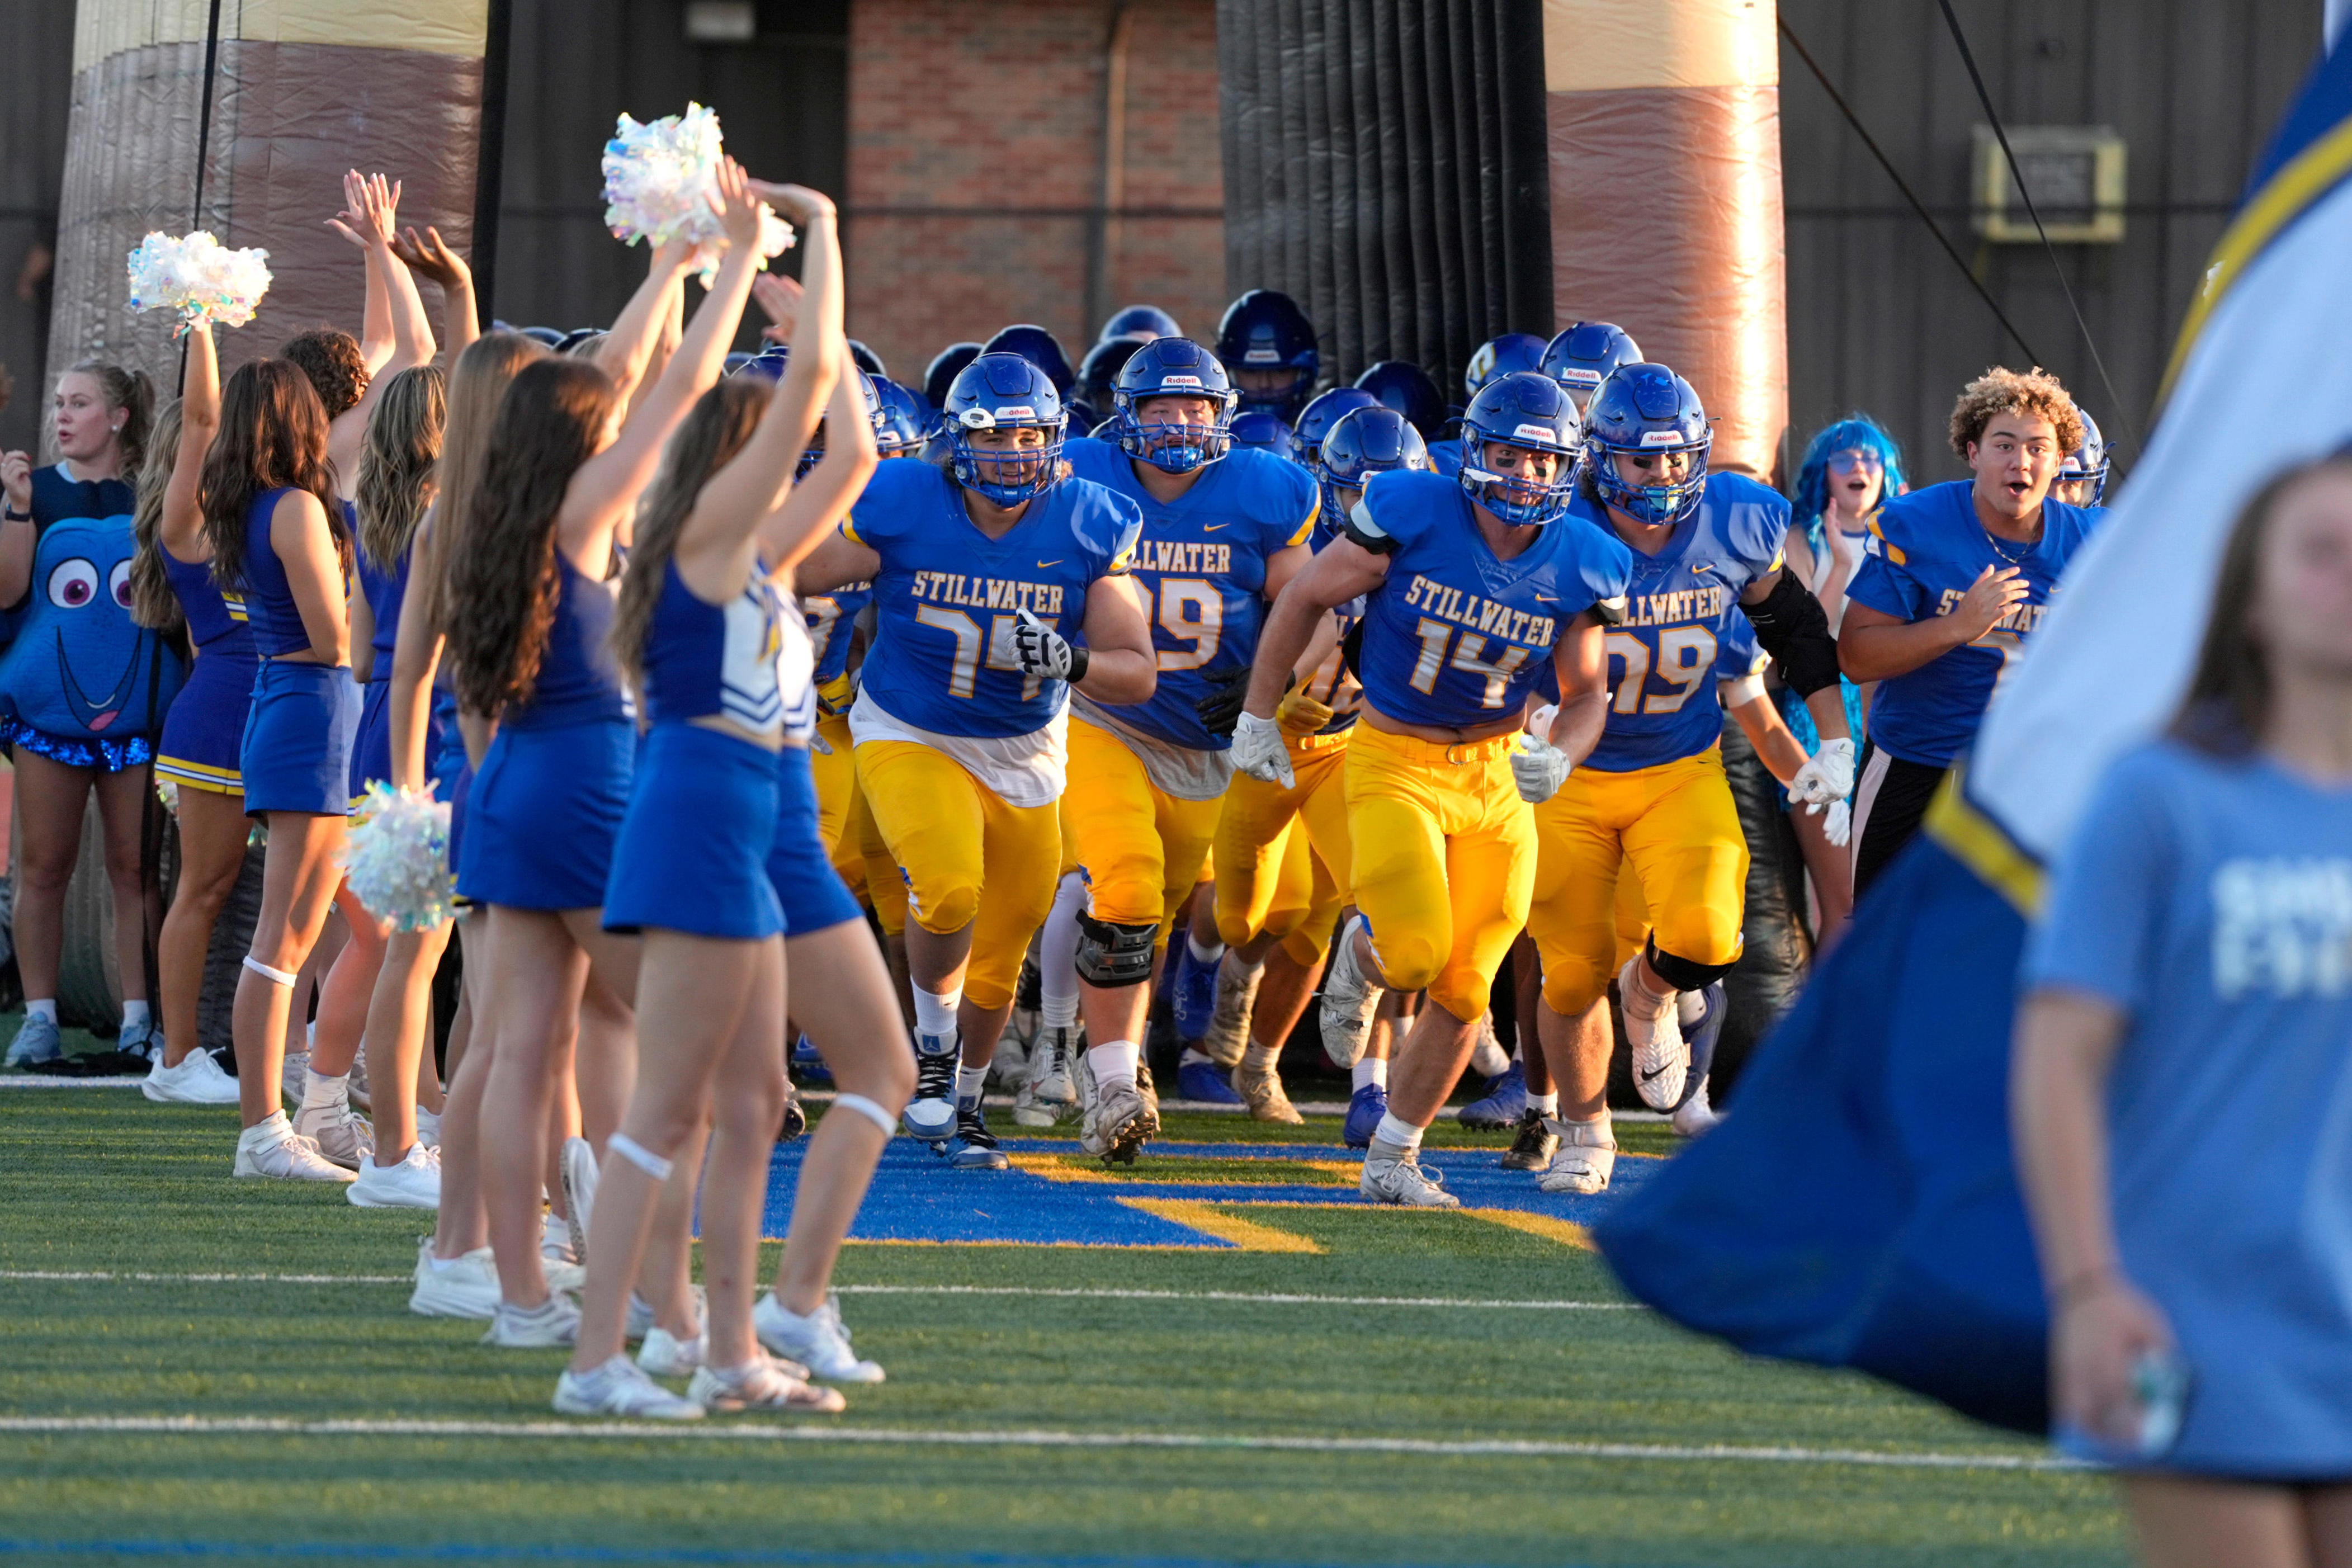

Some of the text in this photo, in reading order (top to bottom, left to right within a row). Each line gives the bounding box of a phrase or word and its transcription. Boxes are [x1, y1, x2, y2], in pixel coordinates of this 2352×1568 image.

[1567, 370, 1596, 379] Riddell
[911, 570, 1064, 614] STILLWATER
[1131, 574, 1223, 670] 9
[1404, 574, 1556, 647] STILLWATER
[1612, 585, 1721, 628] LLWATER
[915, 603, 1059, 702] 74
[1409, 616, 1531, 709] 14
